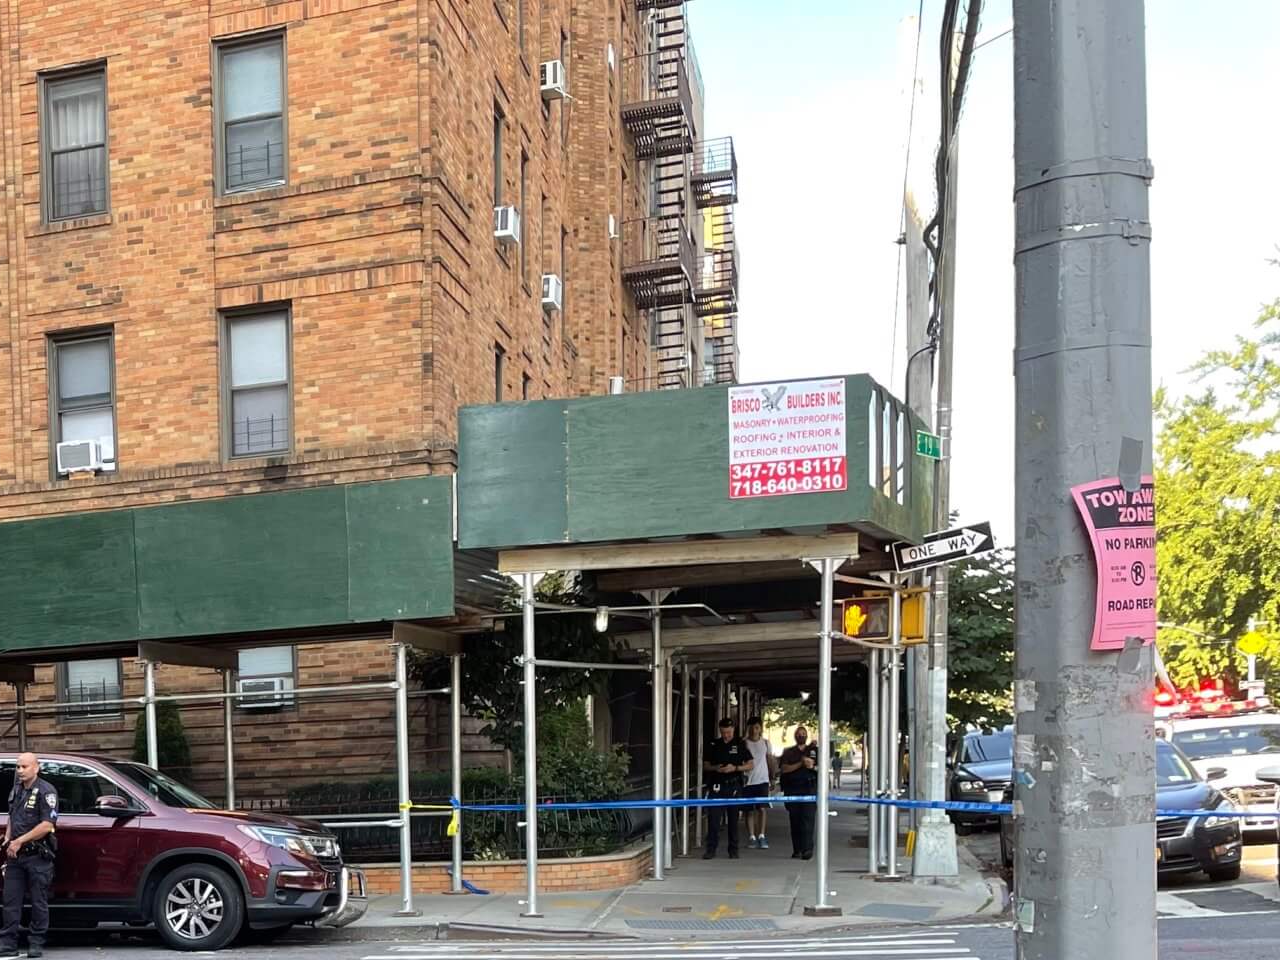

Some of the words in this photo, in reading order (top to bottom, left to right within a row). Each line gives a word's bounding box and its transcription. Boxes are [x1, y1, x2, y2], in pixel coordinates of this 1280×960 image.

[731, 397, 761, 414] BRISCO
[787, 391, 826, 409] BUILDERS
[733, 418, 771, 430] MASONRY
[777, 412, 844, 426] WATERPROOFING
[733, 432, 777, 444] ROOFING
[786, 428, 832, 440] INTERIOR
[733, 446, 778, 459] EXTERIOR
[780, 442, 839, 455] RENOVATION
[731, 457, 842, 480] 347-761-8117
[731, 474, 842, 496] 718-640-0310
[1085, 489, 1127, 508] TOW
[1131, 488, 1154, 505] AW
[1118, 506, 1154, 523] ZONE
[910, 543, 937, 560] ONE
[947, 534, 977, 551] WAY
[1105, 538, 1121, 550] NO
[1108, 599, 1135, 611] ROAD
